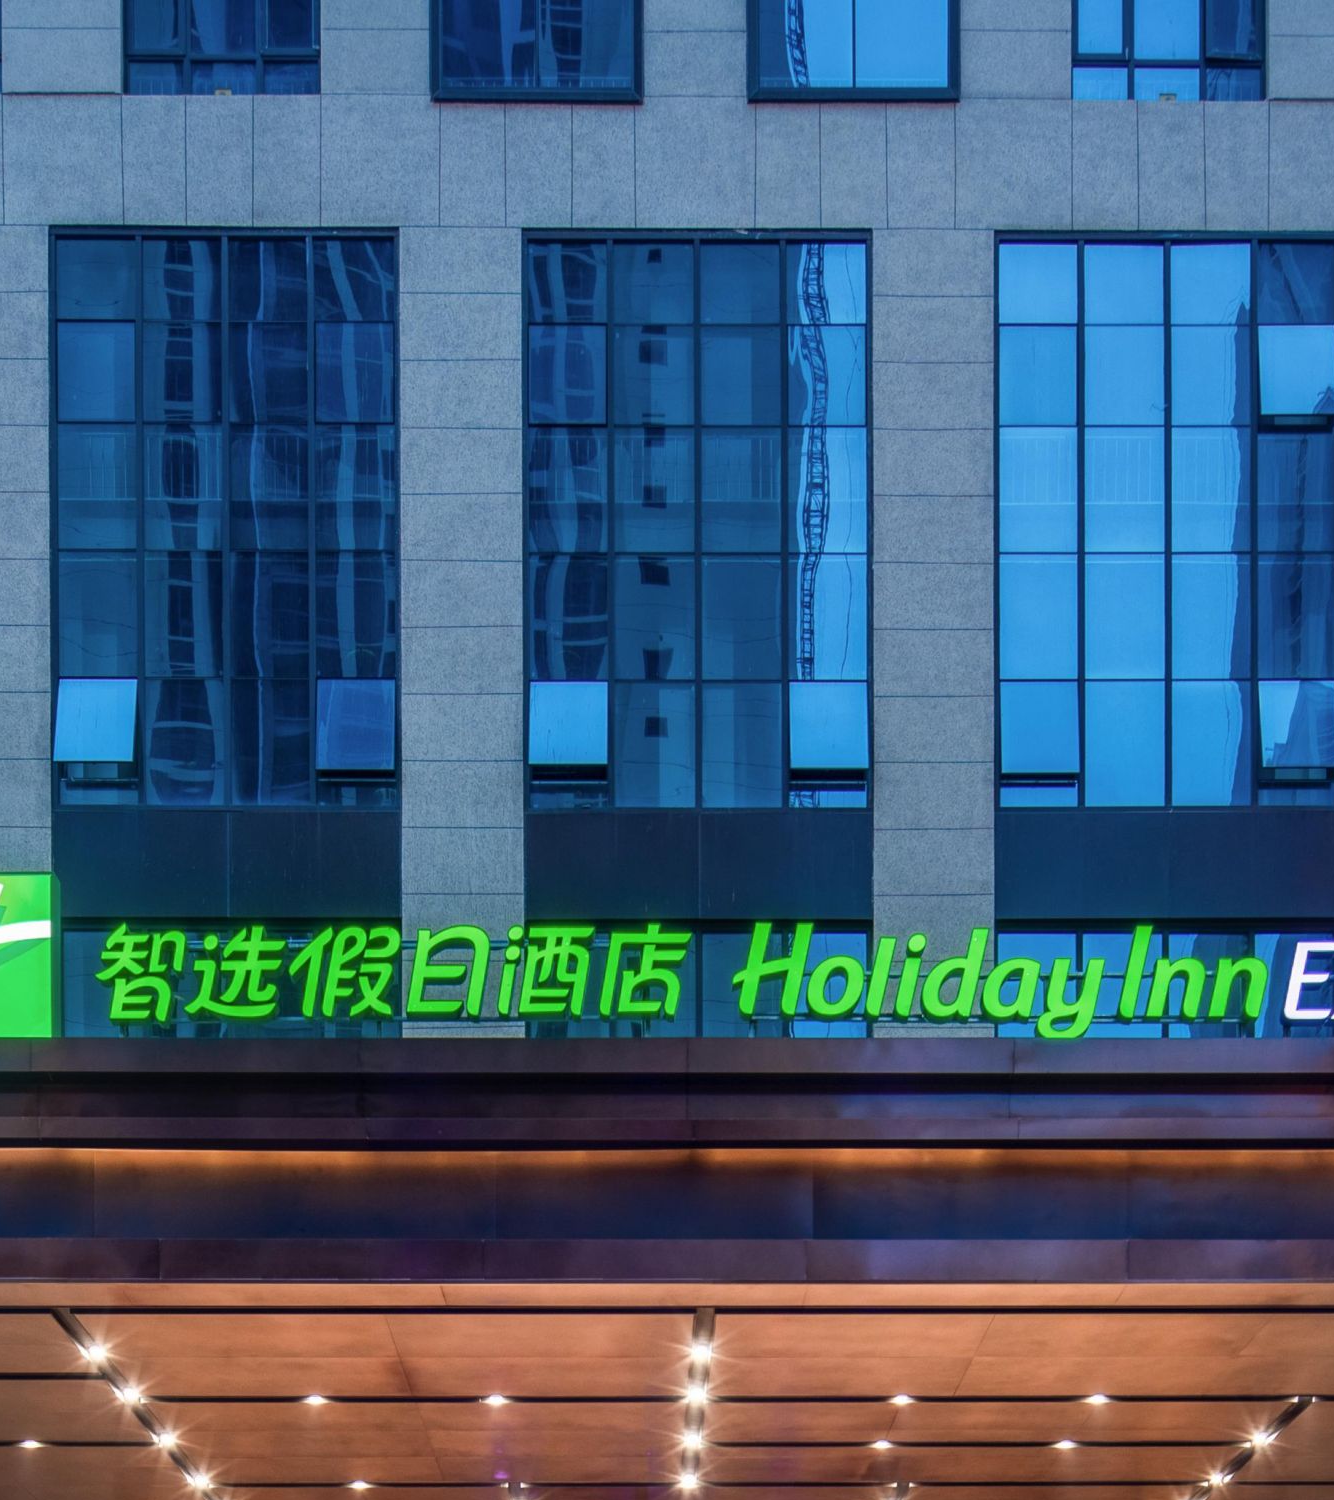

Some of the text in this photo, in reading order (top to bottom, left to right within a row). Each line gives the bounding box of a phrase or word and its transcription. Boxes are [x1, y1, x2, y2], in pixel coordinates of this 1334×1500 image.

[96, 923, 692, 1022] 智选假日酒店
[732, 922, 1105, 1039] Holiday
[1119, 925, 1268, 1018] Inn
